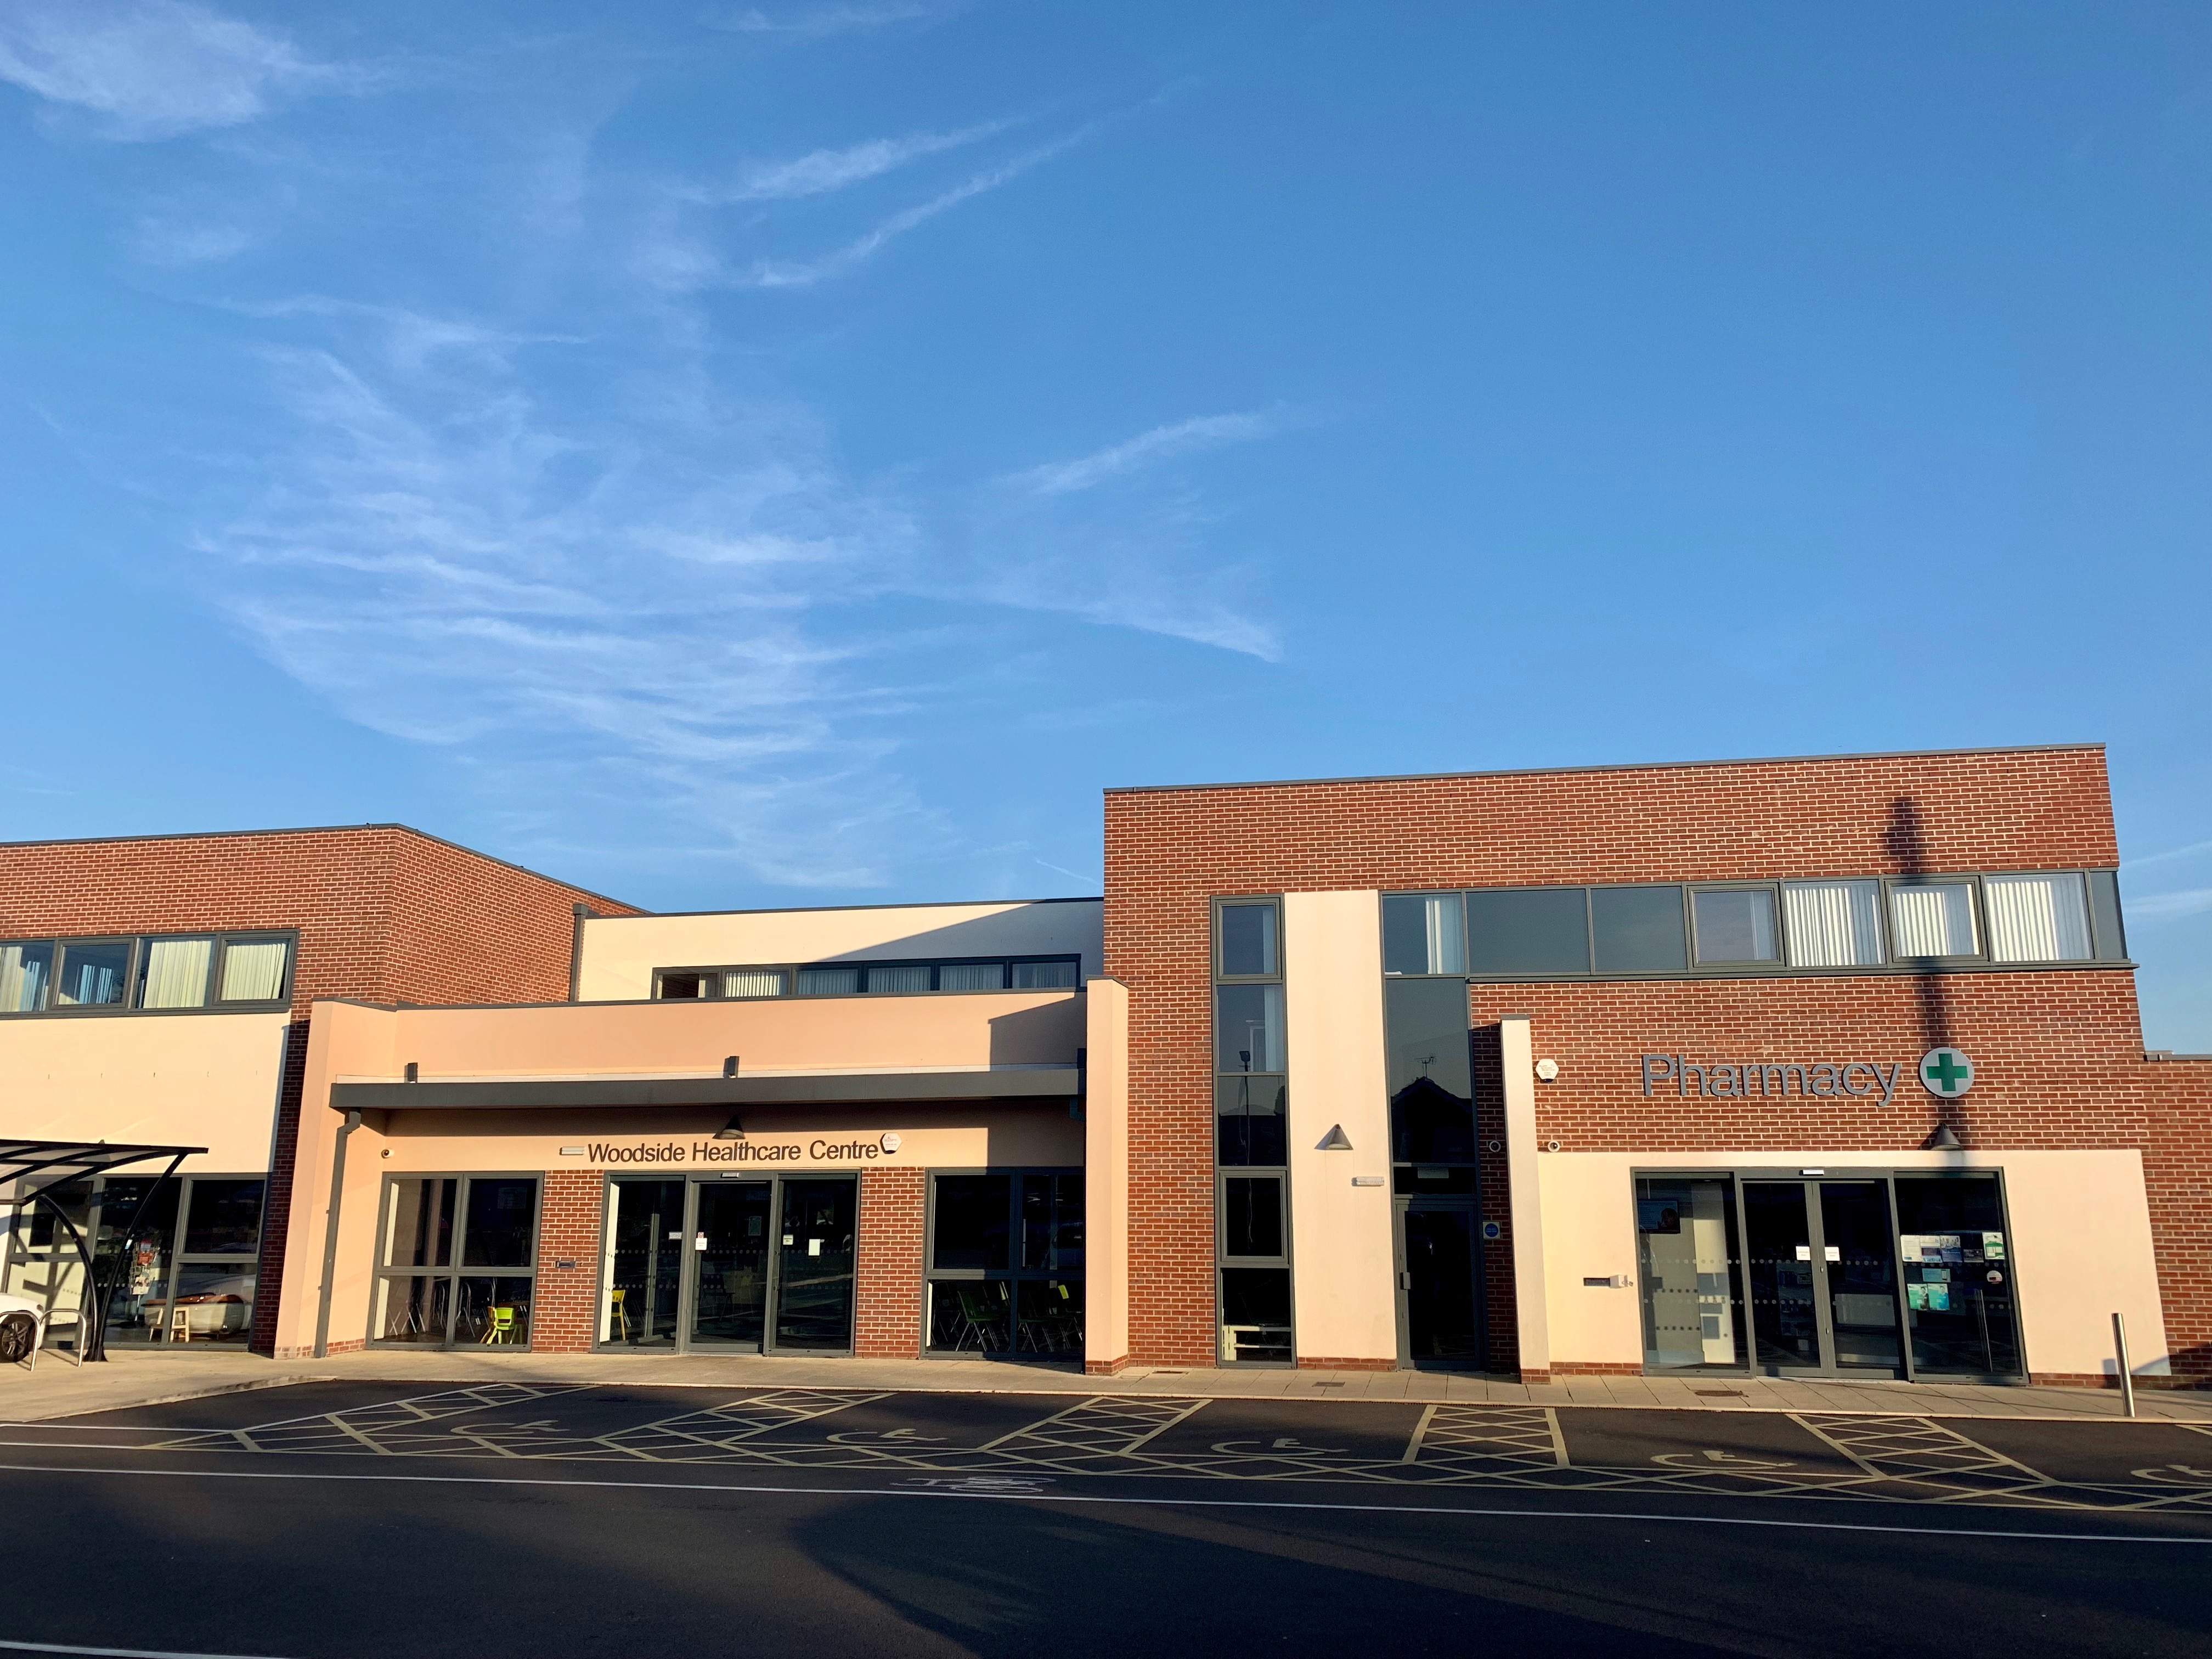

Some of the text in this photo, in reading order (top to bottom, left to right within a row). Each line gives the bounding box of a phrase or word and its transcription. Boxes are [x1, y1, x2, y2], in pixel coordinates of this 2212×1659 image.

[1641, 1054, 1901, 1107] Pharmacy
[588, 1140, 878, 1163] Woodside Healthcare Centre
